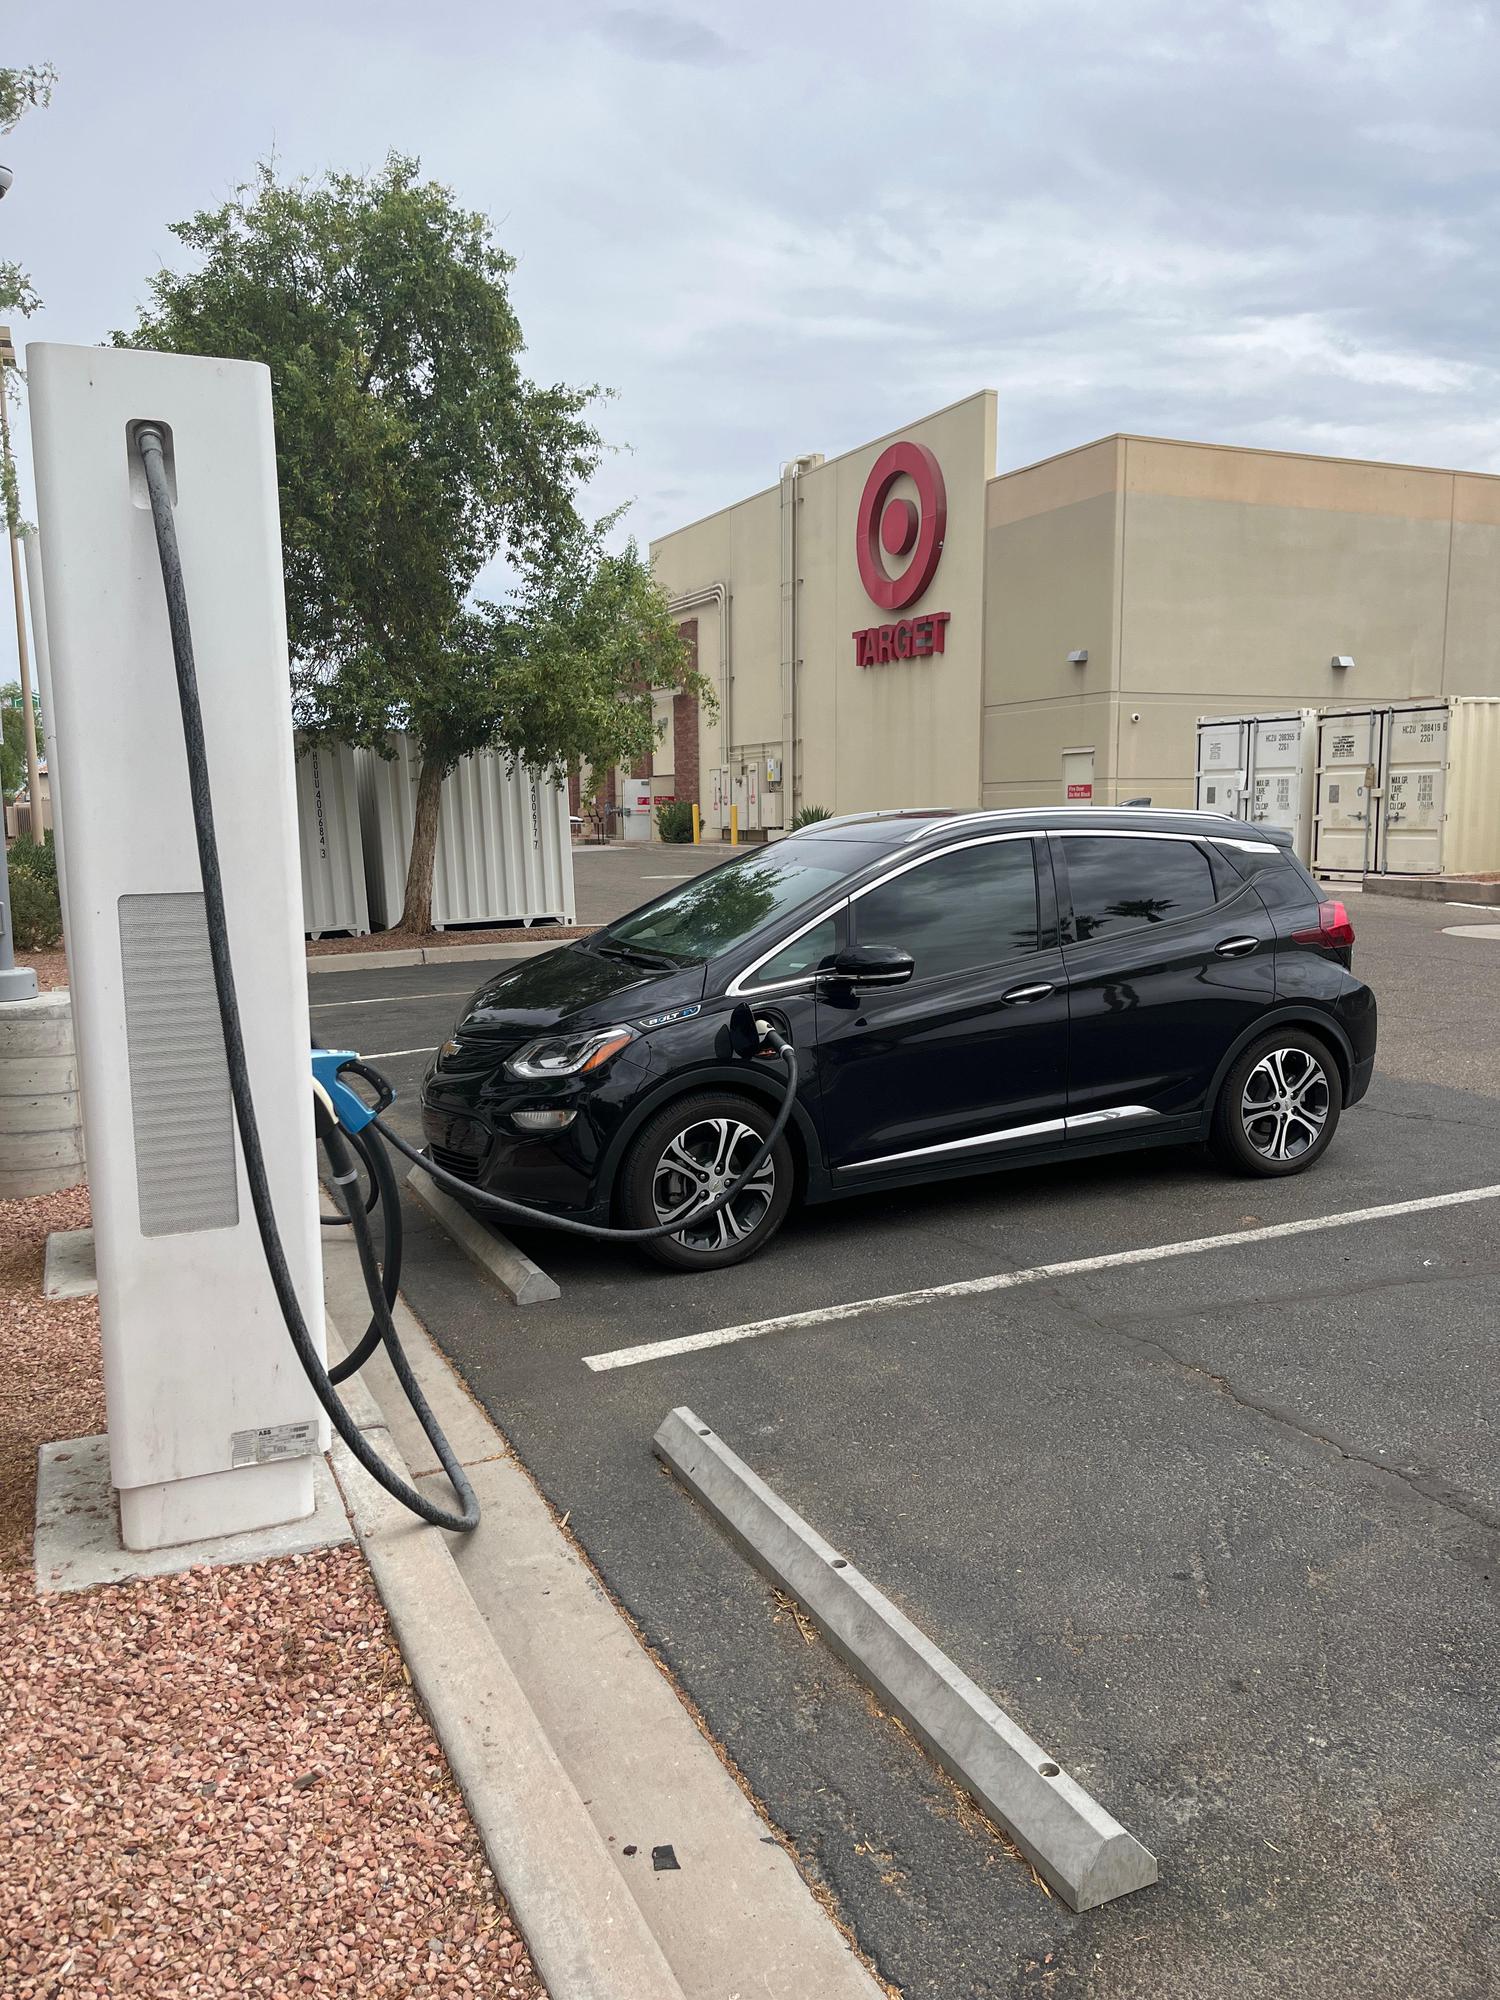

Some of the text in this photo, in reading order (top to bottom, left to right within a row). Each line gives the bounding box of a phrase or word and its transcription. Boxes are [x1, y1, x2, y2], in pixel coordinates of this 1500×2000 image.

[852, 611, 951, 667] TARGET
[315, 790, 325, 845] 400684
[530, 785, 538, 837] 400677
[649, 1008, 697, 1025] BOLT EV
